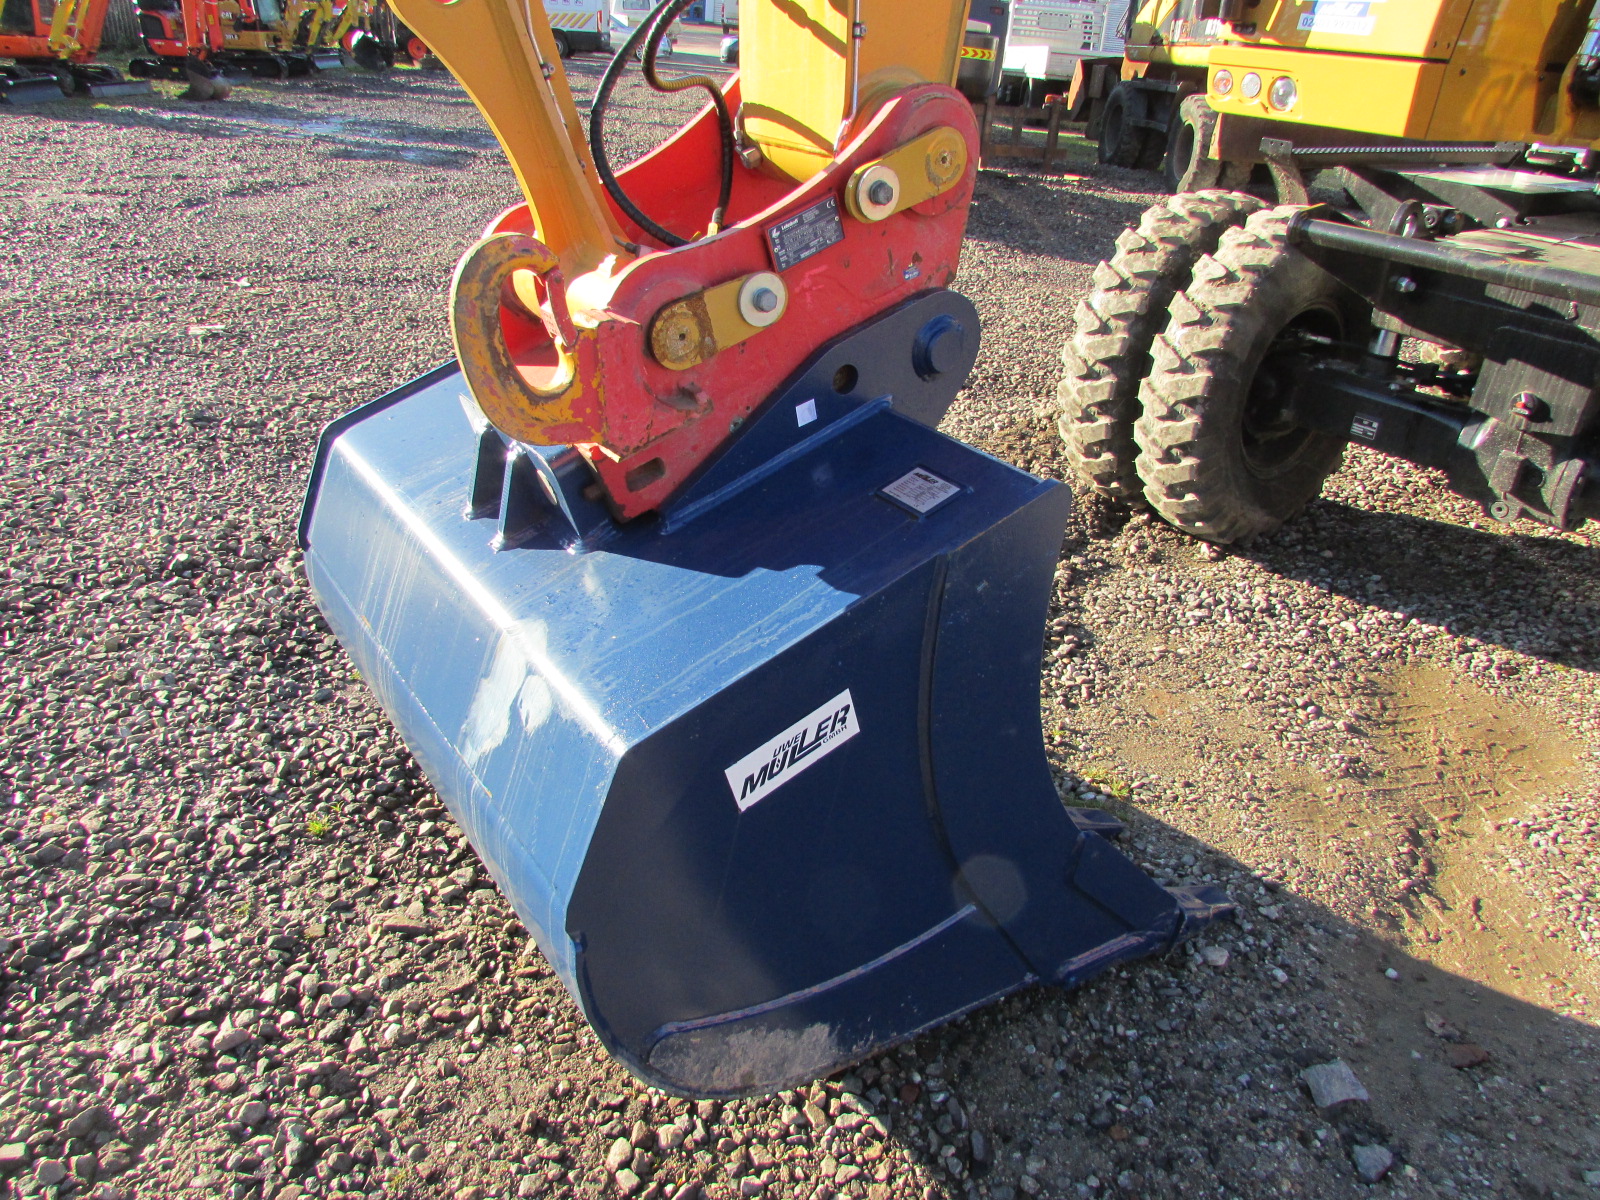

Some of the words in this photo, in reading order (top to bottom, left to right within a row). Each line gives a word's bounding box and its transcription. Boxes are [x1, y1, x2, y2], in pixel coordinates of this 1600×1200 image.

[221, 11, 233, 19] CAT
[773, 732, 802, 758] UWE
[822, 725, 847, 743] GMBH
[740, 704, 850, 801] MÜLLER
